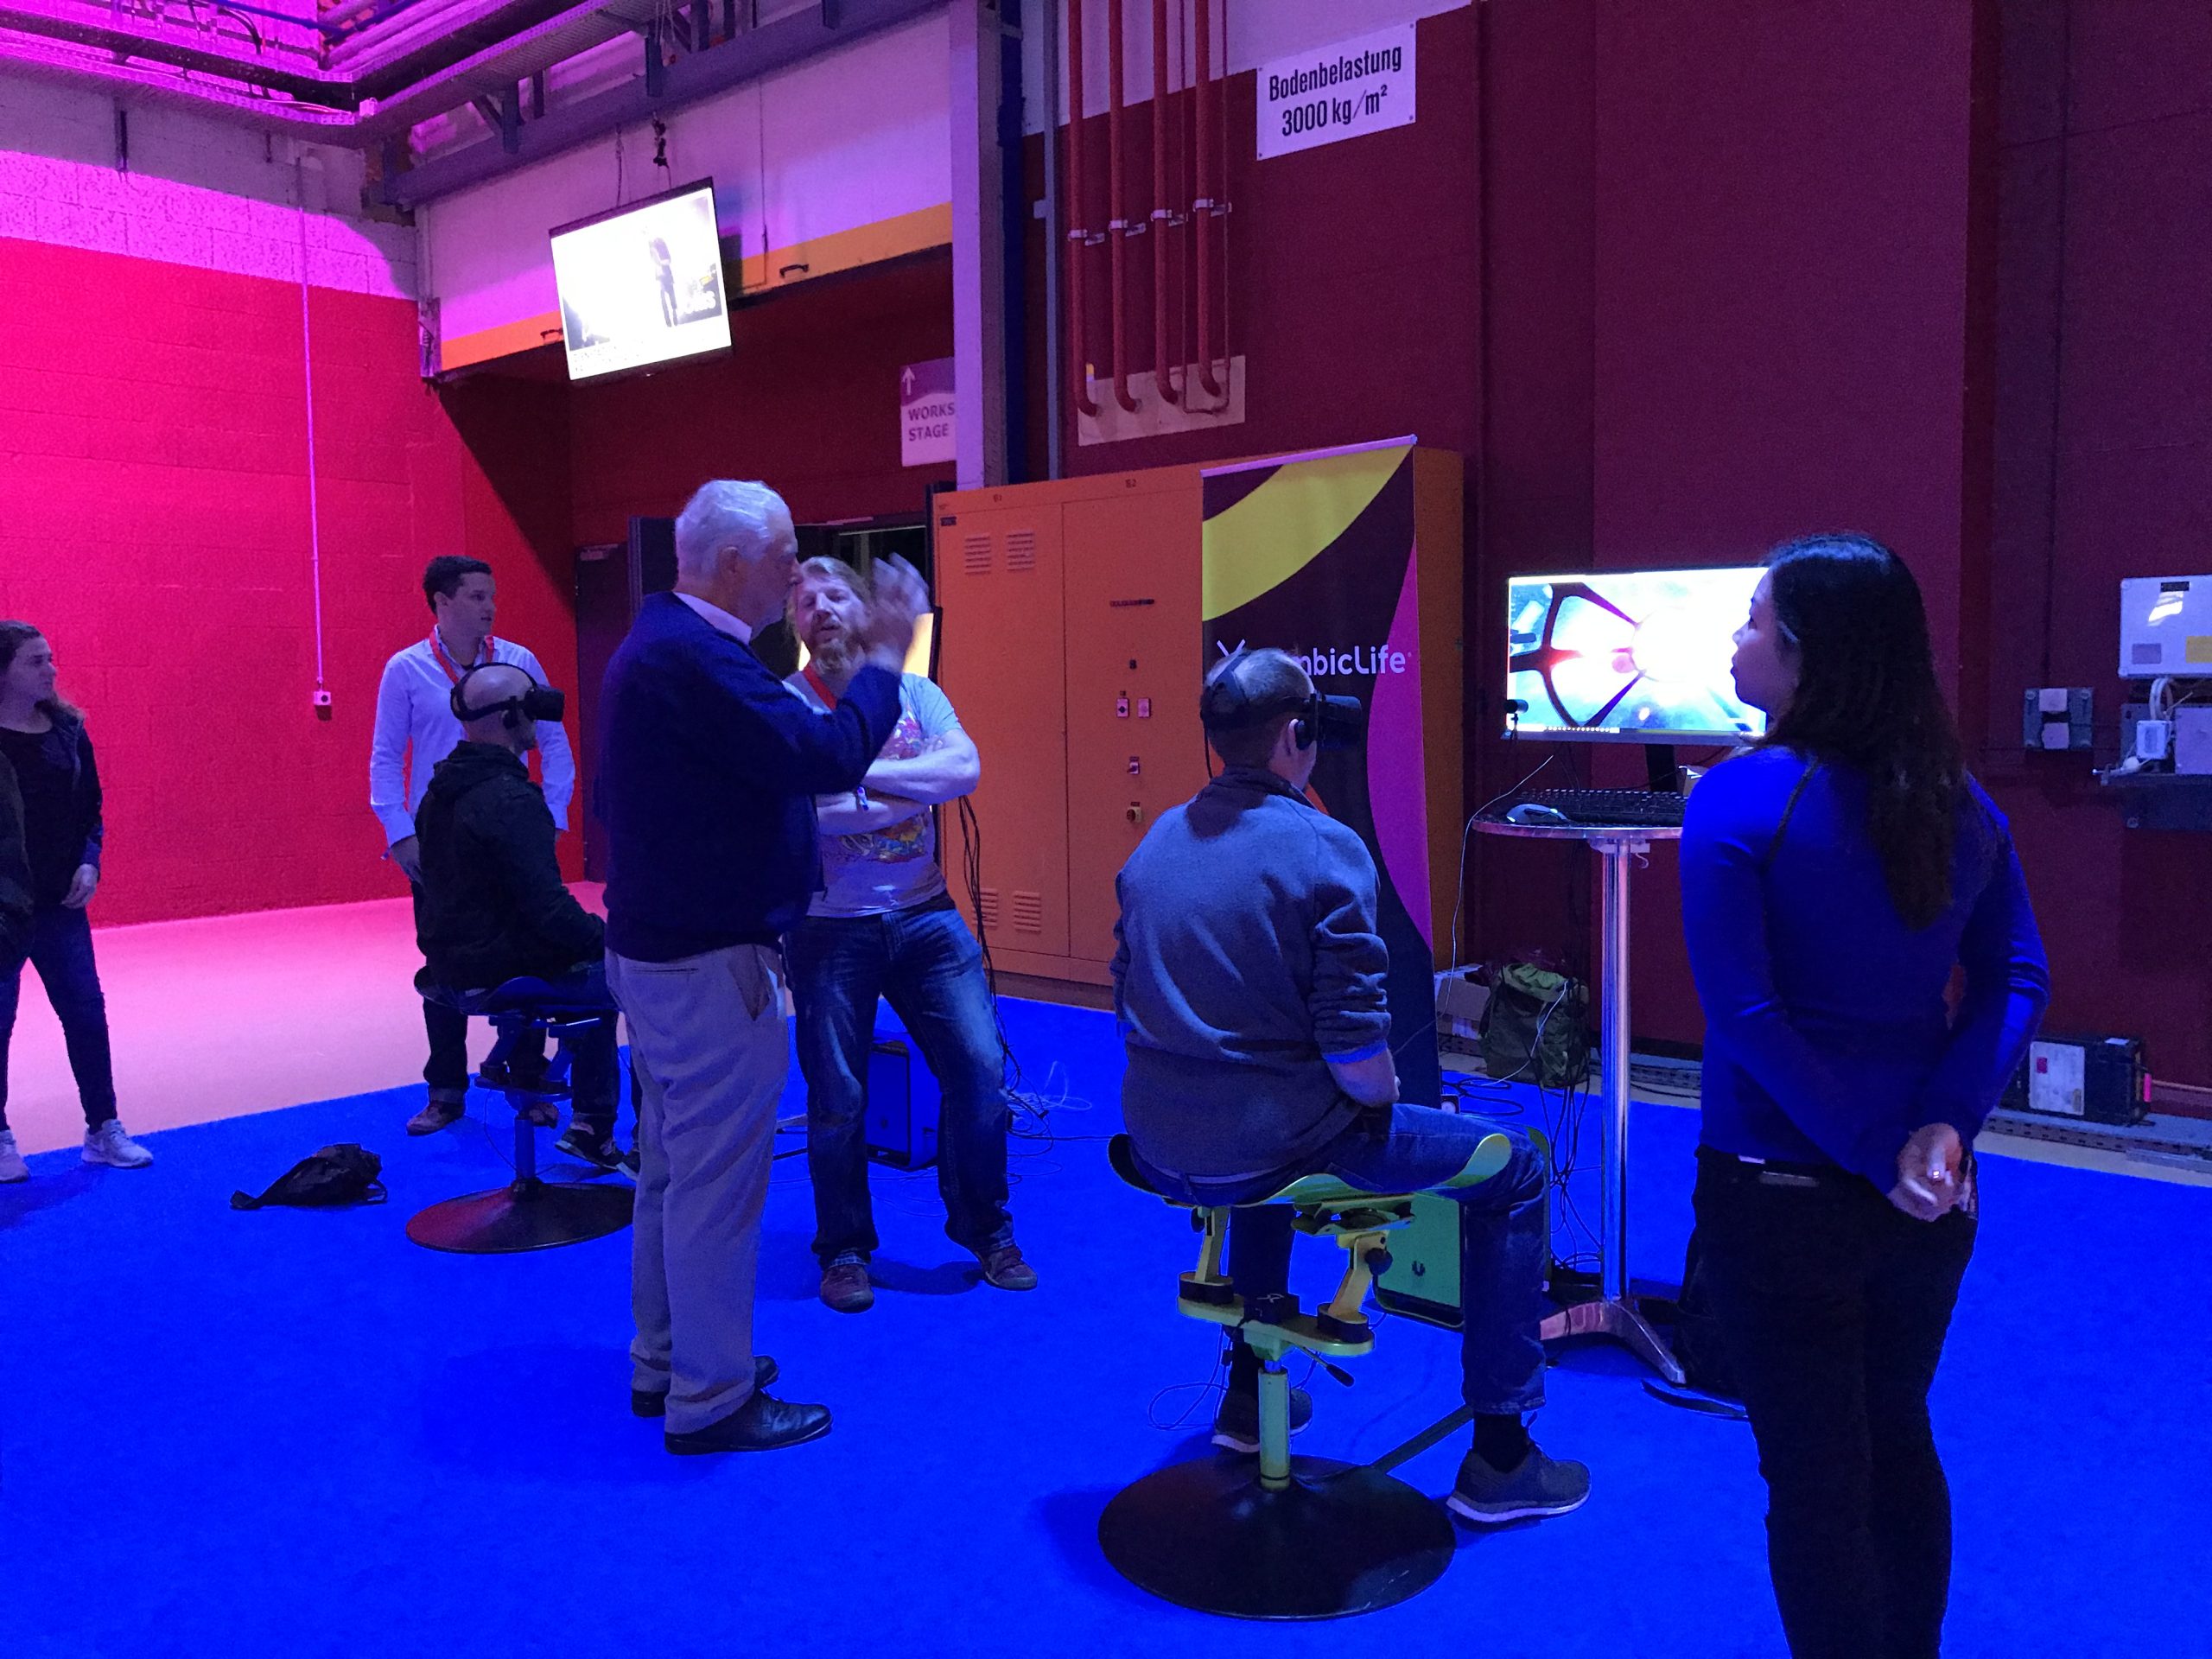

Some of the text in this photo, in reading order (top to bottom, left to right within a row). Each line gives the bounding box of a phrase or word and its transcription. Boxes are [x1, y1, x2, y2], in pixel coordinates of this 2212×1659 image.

[1268, 46, 1402, 102] Bodenbelastung
[1281, 99, 1328, 137] 3000
[907, 402, 956, 422] WORKS
[907, 423, 950, 442] STAGE
[1290, 644, 1406, 676] mbicLife
